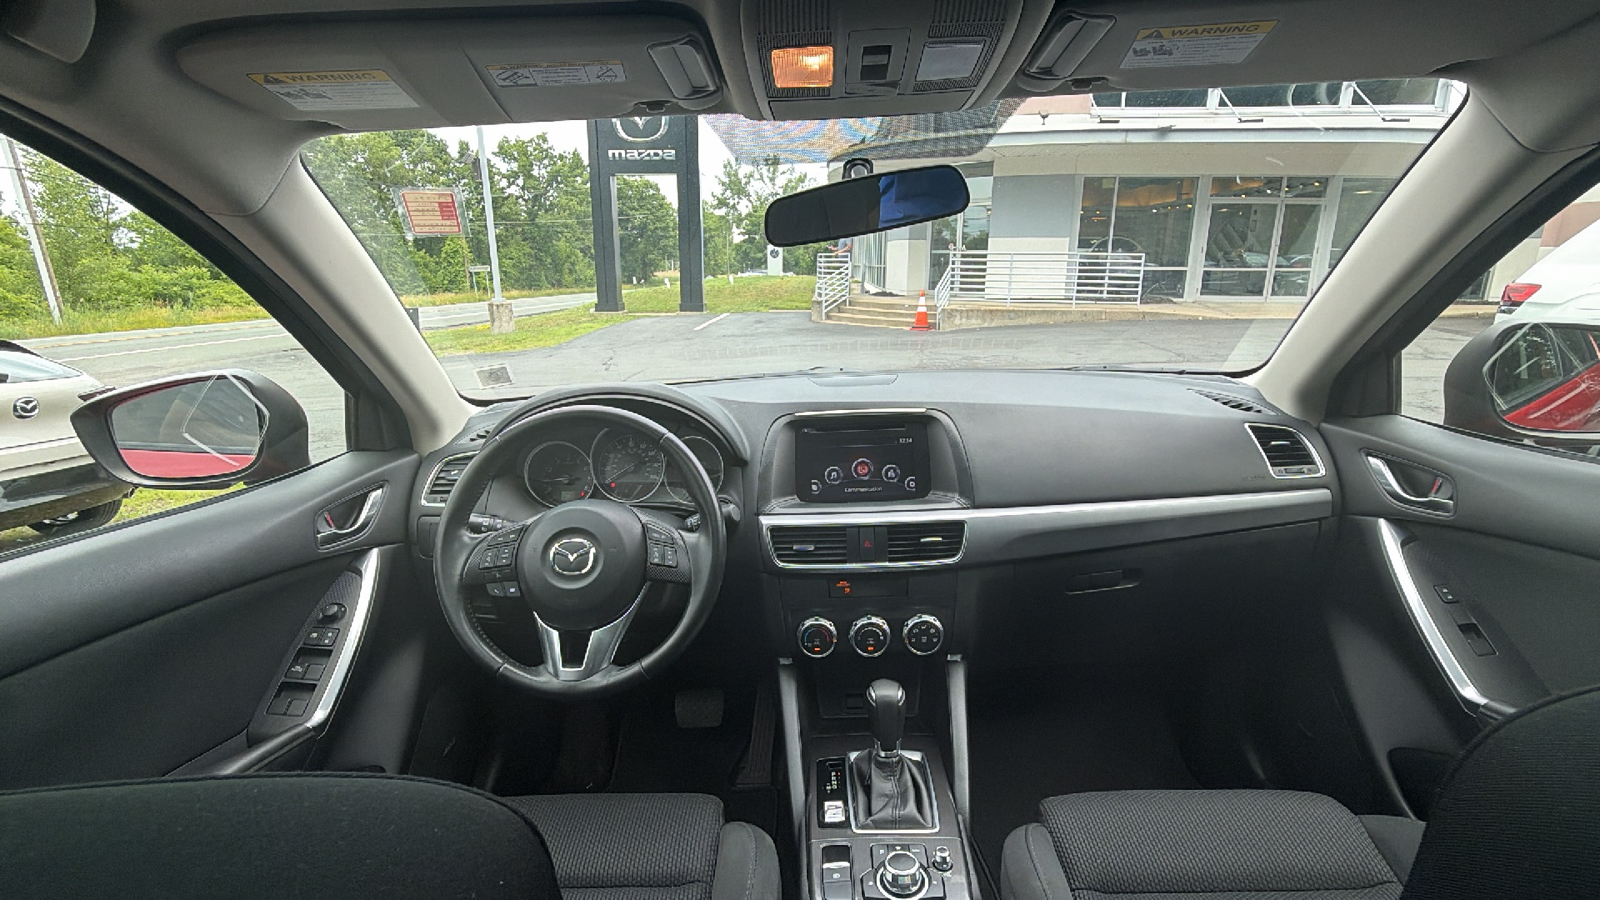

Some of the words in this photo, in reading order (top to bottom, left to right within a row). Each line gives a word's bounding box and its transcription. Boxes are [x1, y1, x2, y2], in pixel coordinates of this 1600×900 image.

[1171, 24, 1260, 37] WARNING
[285, 72, 376, 82] WARNING
[608, 150, 676, 160] mazda
